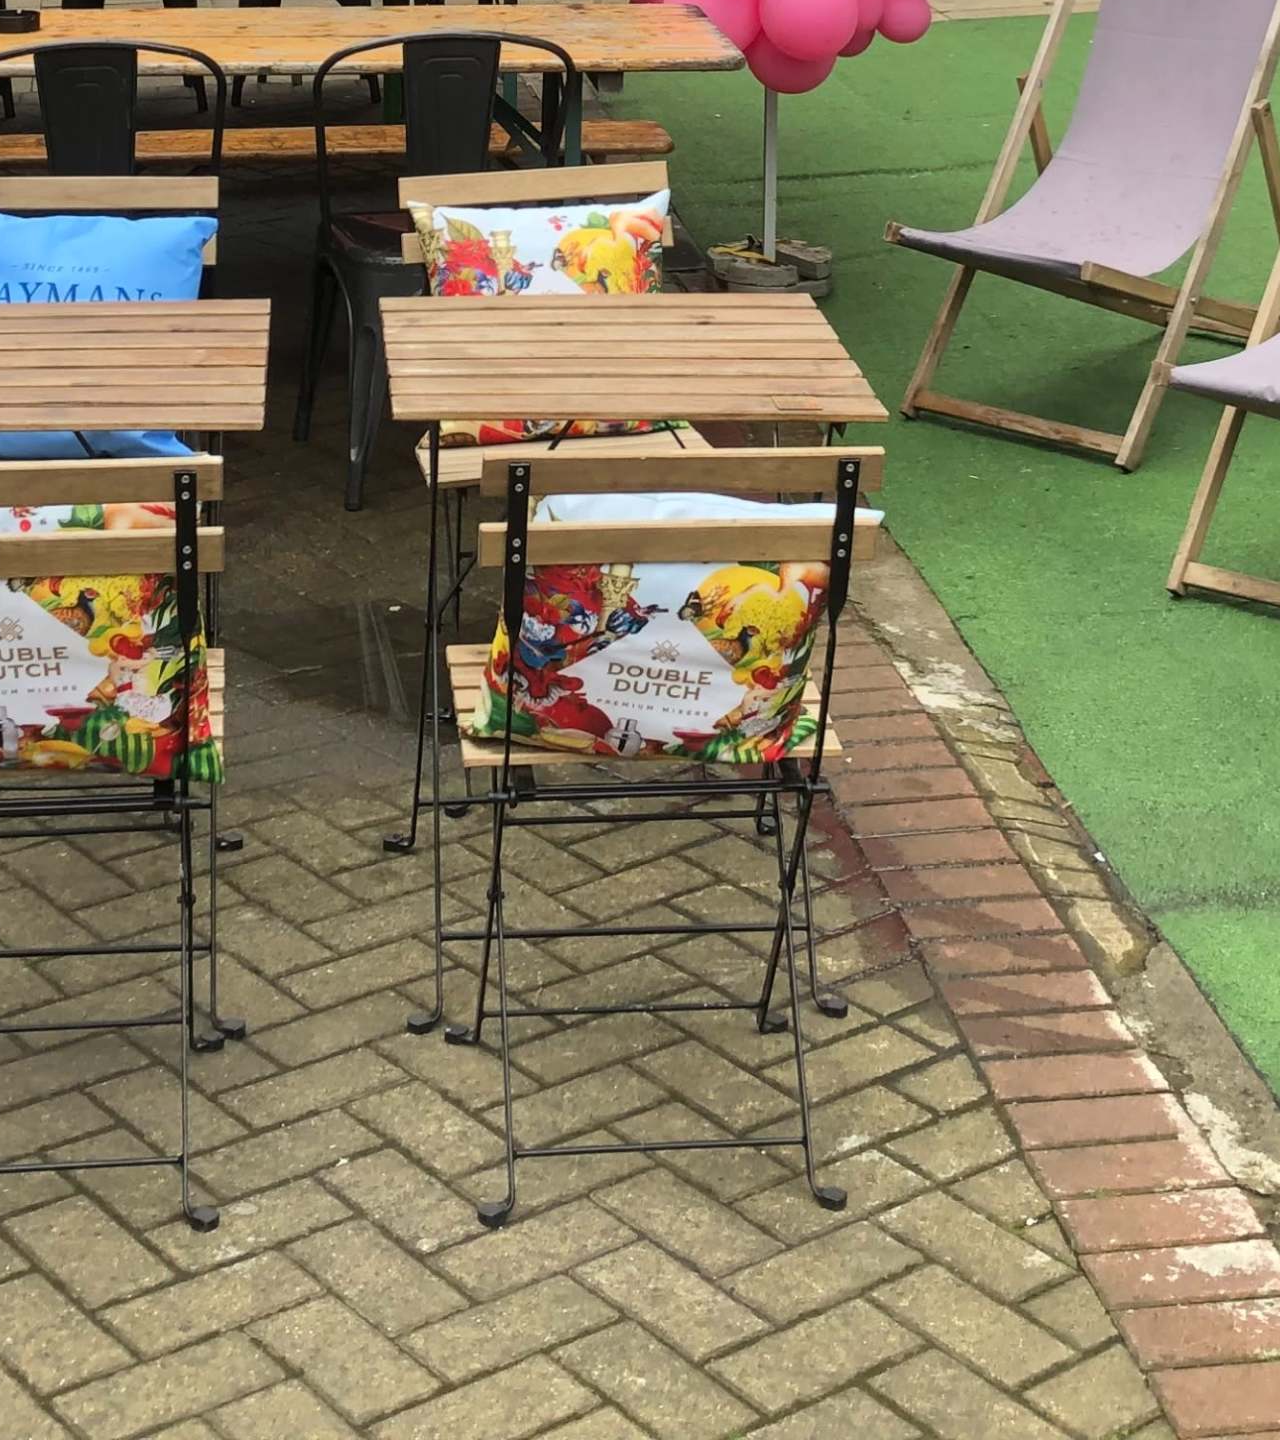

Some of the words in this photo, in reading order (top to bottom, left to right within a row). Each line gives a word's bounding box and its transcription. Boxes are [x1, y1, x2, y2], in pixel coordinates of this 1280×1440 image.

[607, 662, 713, 686] DOUBLE
[27, 685, 78, 693] MIXERS
[613, 678, 701, 701] DUTCH
[596, 697, 654, 710] PREMIUM
[662, 707, 709, 717] MIXERS
